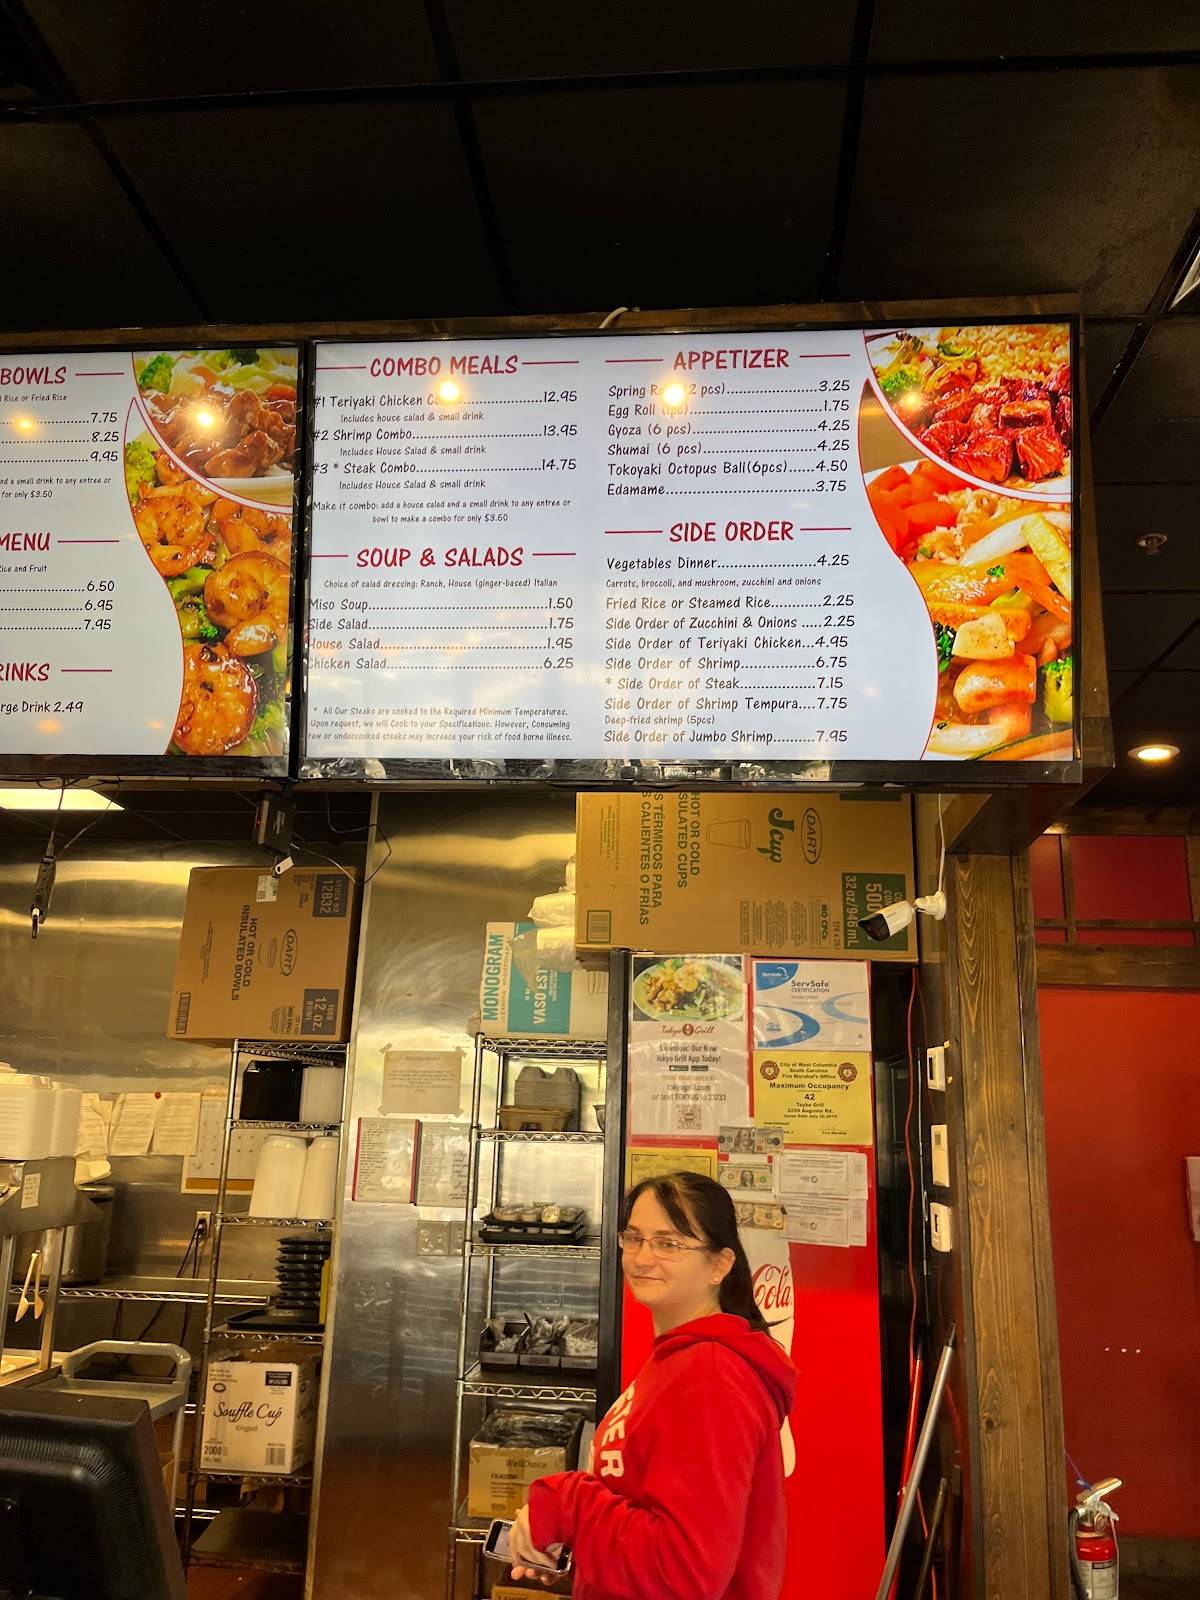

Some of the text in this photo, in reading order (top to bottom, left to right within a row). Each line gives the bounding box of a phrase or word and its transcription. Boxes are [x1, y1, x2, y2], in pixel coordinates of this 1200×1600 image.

[371, 355, 518, 377] COMBO MEALS
[674, 349, 789, 369] APPETIZER
[1, 367, 66, 385] BOWLS
[609, 385, 645, 399] Spring
[701, 382, 725, 398] pcs)
[818, 380, 849, 391] 3.25
[330, 396, 375, 410] Teriyaki
[380, 395, 422, 406] Chicken
[544, 391, 577, 402] 12.95
[609, 405, 629, 418] Egg
[635, 404, 655, 415] Roll
[825, 400, 849, 411] 1.75
[91, 412, 117, 423] 7.75
[92, 432, 119, 442] 8.25
[333, 429, 371, 443] Shrimp
[377, 428, 414, 439] Combo
[544, 425, 577, 436] 13.95
[609, 420, 849, 438] Gyoza (6 pcs) 4.25
[91, 451, 117, 461] 9.95
[608, 440, 849, 457] Shumai (6 pcs) 4.25
[344, 462, 375, 473] Steak
[381, 462, 415, 473] Combo
[542, 459, 576, 470] 14.75
[608, 463, 661, 478] Tokoyaki
[668, 463, 716, 477] Octopus
[816, 460, 847, 471] 4.50
[608, 480, 846, 495] Edamame 3.75
[670, 521, 793, 542] SIDE ORDER
[357, 547, 523, 567] SOUP & SALADS
[607, 555, 849, 572] Vegetables Dinner 4.25
[87, 581, 114, 591] 6.50
[85, 600, 112, 610] 6.95
[341, 599, 367, 613] Soup
[548, 597, 572, 609] 1.50
[607, 595, 853, 609] Fried Rice or Steamed Rice 2.25
[84, 619, 111, 630] 7.95
[308, 617, 573, 630] Side Salad 1.75
[606, 616, 854, 629] Side Order of Zucchini & Onions 2.25
[349, 638, 382, 649] Salad
[547, 638, 572, 649] 1.95
[356, 658, 386, 669] Salad
[543, 657, 573, 668] 6.25
[1, 701, 83, 715] rge Drink 2.49
[640, 802, 651, 870] CALIENTES
[690, 821, 700, 838] OR
[806, 814, 818, 858] DART
[677, 793, 688, 888] SULATED CUPS
[690, 842, 700, 876] COLD
[652, 874, 662, 908] PARA
[231, 904, 250, 1001] INSULATED BOWLS
[242, 918, 258, 988] HOT OR COLD
[283, 934, 296, 971] DART
[482, 934, 504, 1020] MONOGRAM
[791, 980, 830, 988] ServSafe
[533, 992, 548, 1024] VASO
[808, 1082, 850, 1090] Occupancy
[214, 1402, 283, 1426] Souffle Cup
